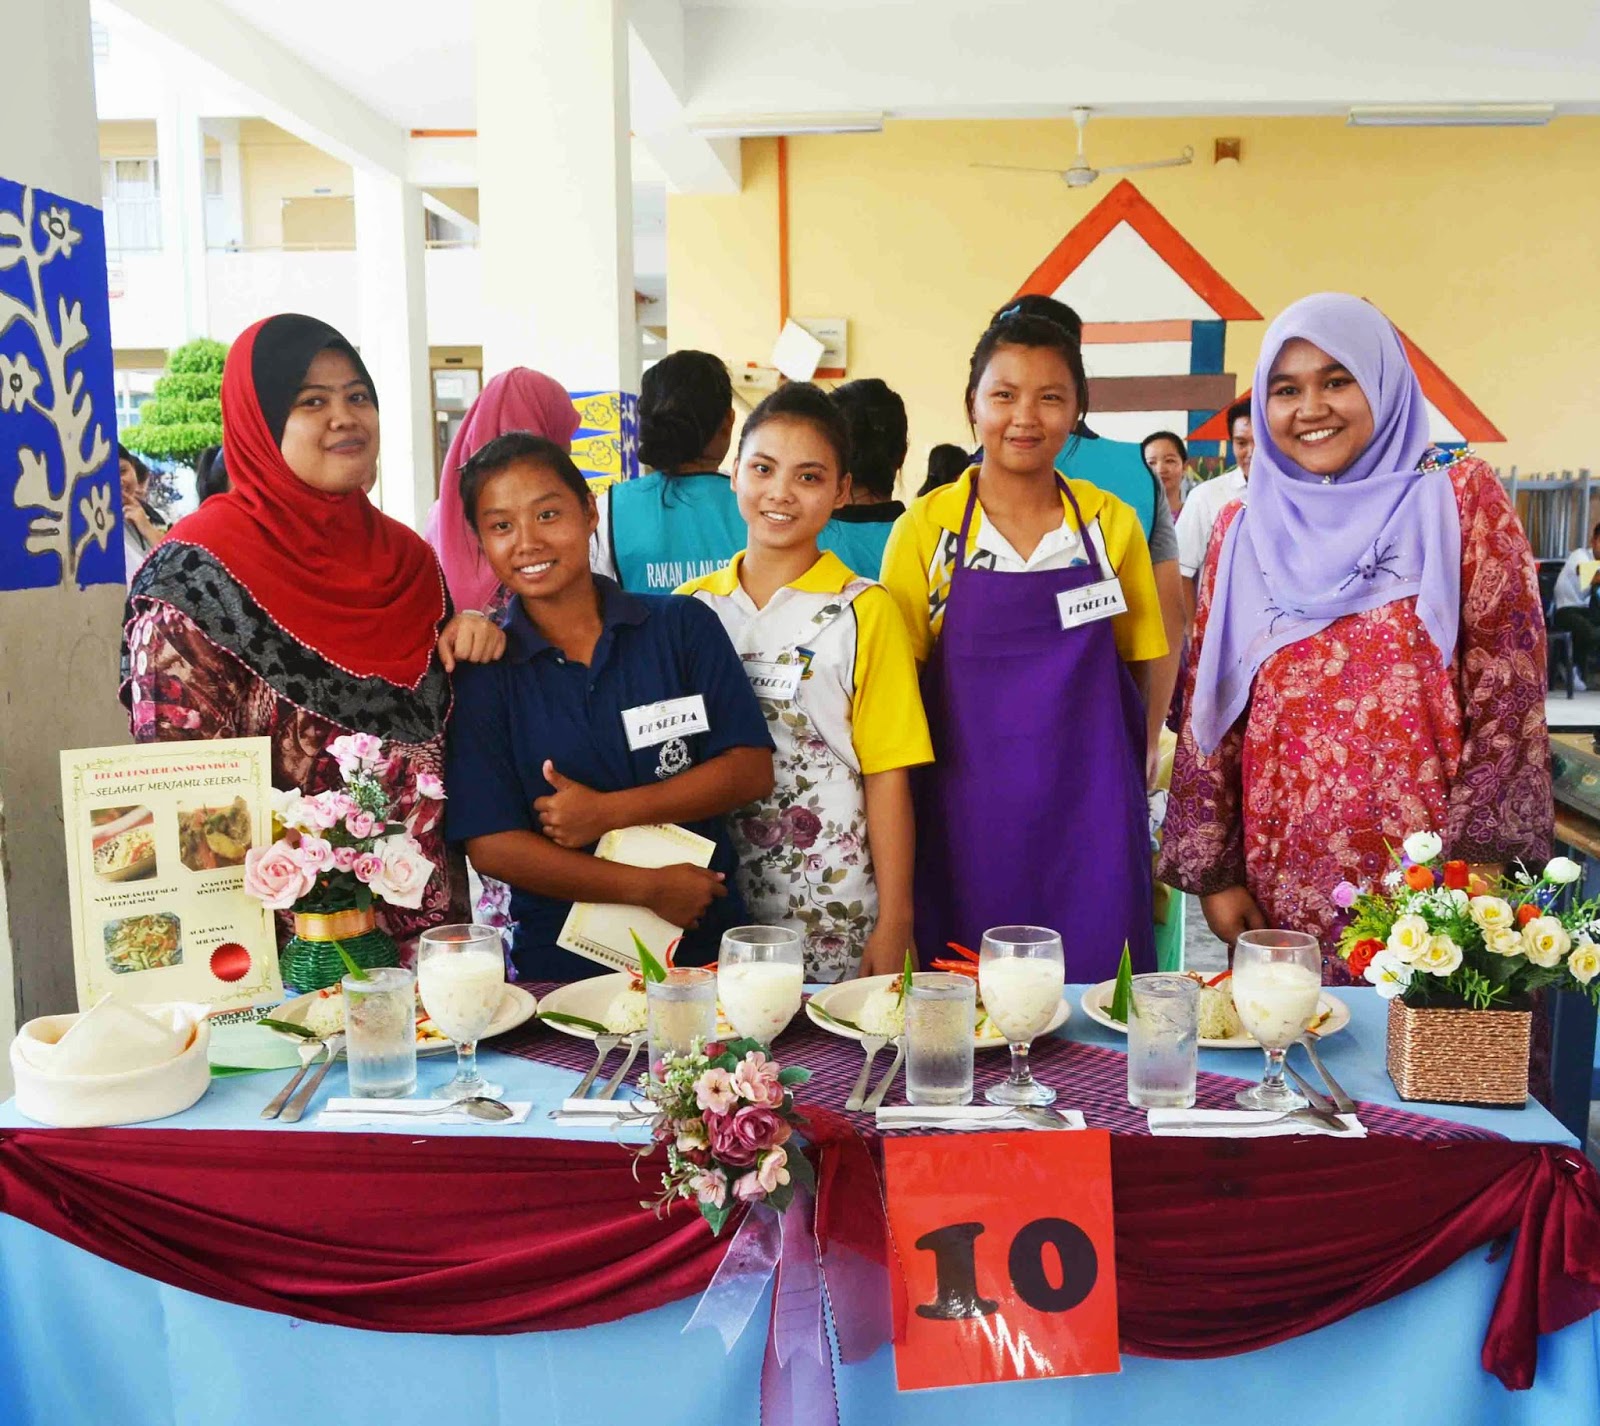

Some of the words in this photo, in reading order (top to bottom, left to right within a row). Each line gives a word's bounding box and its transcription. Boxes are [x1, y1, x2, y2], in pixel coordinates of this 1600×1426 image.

[646, 562, 682, 588] RAKAN
[1069, 595, 1118, 616] PESERTA
[638, 712, 698, 736] PESERTA
[148, 779, 200, 791] MENJAMU
[915, 1217, 1098, 1320] 10
